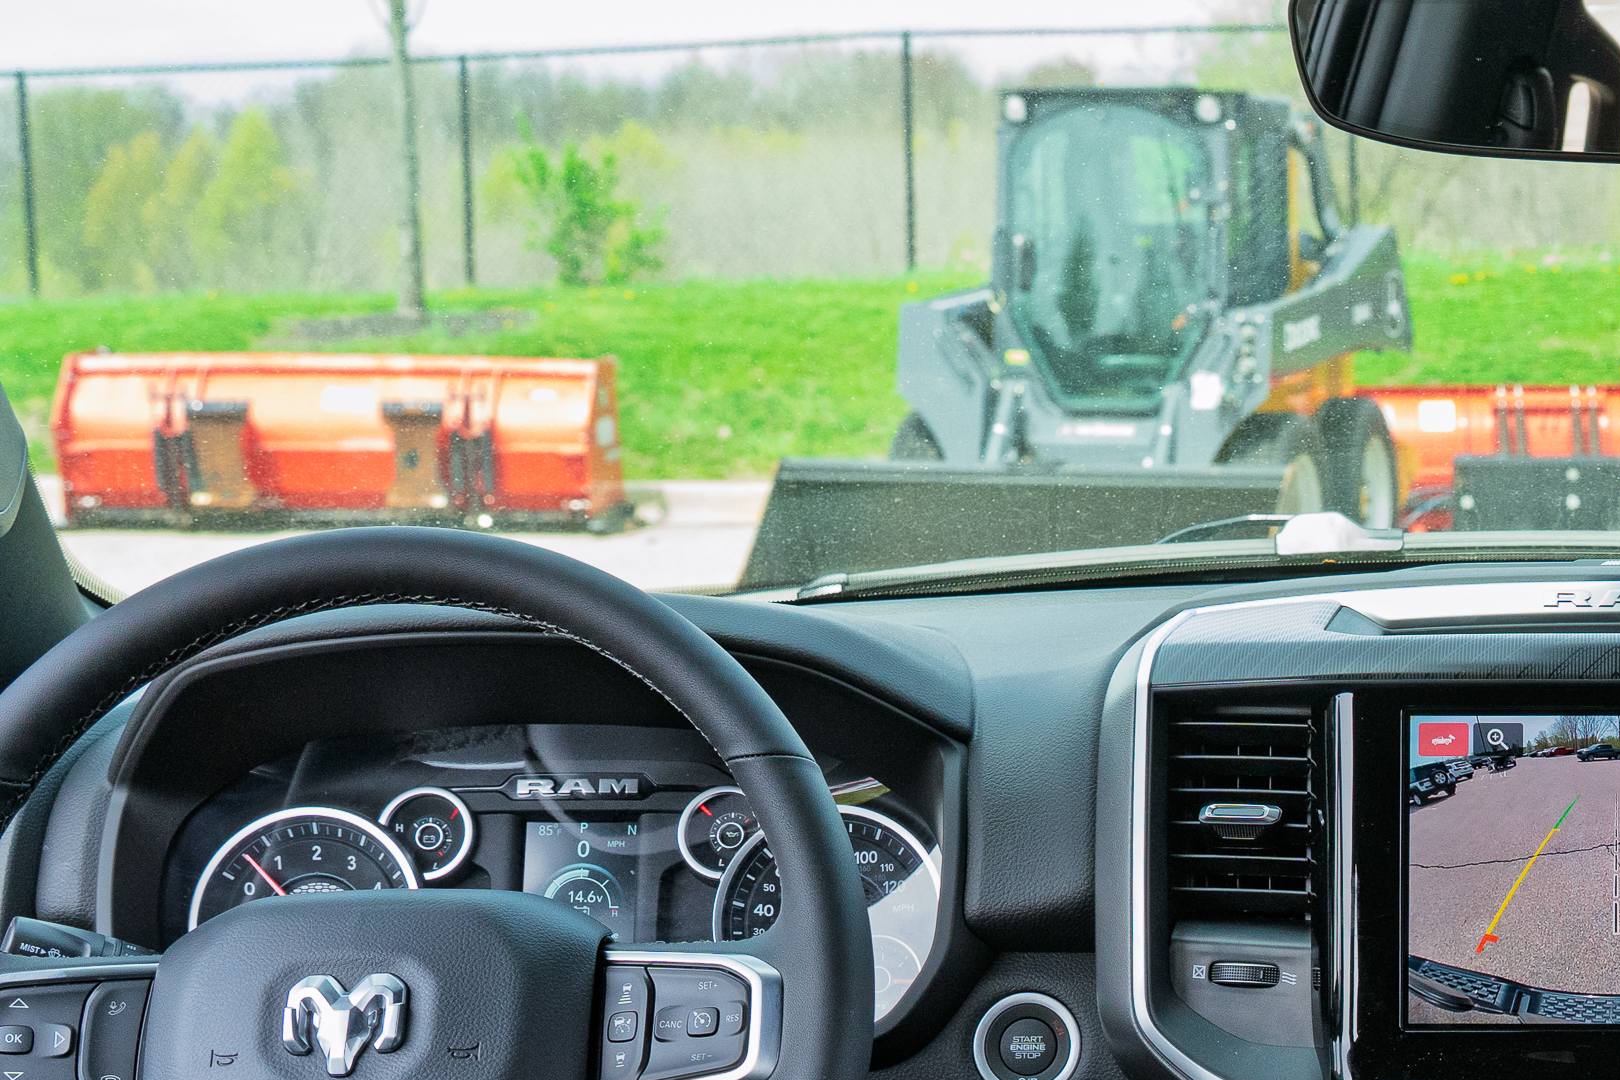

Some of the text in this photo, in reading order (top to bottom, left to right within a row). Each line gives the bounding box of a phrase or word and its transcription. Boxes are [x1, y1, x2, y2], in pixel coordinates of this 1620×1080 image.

[516, 778, 639, 797] RAM
[395, 823, 404, 833] H
[580, 822, 589, 834] P
[627, 824, 637, 836] N
[577, 840, 590, 858] 0
[607, 840, 625, 848] MPH
[311, 845, 322, 861] 2
[854, 850, 878, 865] 100
[273, 855, 283, 870] 1
[346, 855, 357, 871] 3
[718, 858, 725, 867] L
[880, 863, 895, 872] 110
[243, 881, 256, 896] 0
[763, 883, 776, 893] 50
[882, 880, 907, 894] 120
[753, 903, 775, 917] 40
[892, 903, 915, 913] MPH
[20, 942, 41, 954] MIST
[698, 981, 718, 990] SET+
[725, 1014, 740, 1023] RES
[659, 1020, 683, 1029] CANC
[4, 1034, 22, 1043] OK
[1012, 1035, 1043, 1043] START
[1014, 1052, 1041, 1060] STOP
